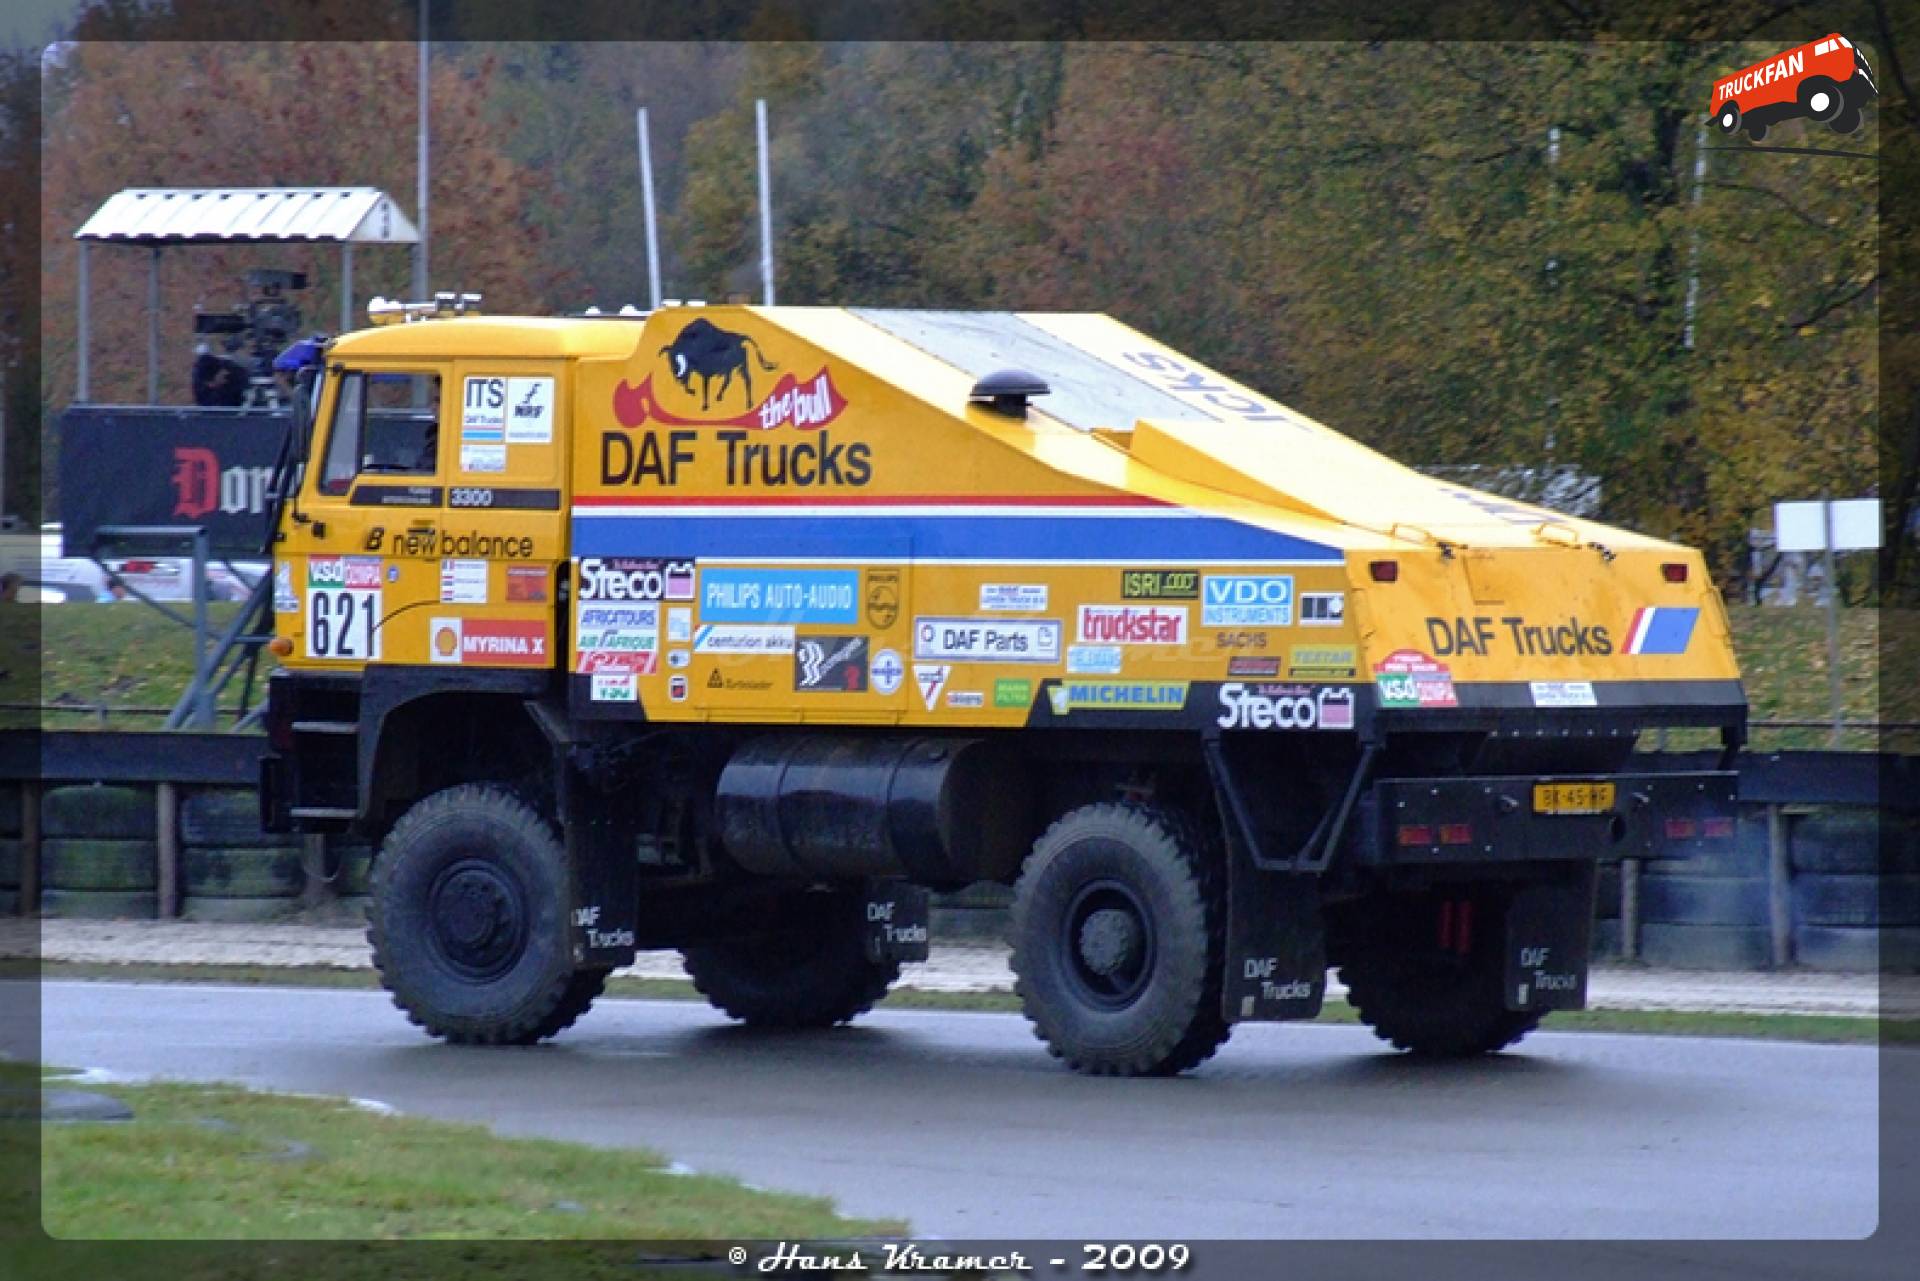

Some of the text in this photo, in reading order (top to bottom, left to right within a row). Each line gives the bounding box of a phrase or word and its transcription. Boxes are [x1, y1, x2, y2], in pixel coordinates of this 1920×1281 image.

[466, 378, 504, 408] ITS
[759, 373, 832, 429] the bull
[601, 430, 872, 486] DAF Trucks
[450, 489, 492, 506] 3300
[393, 533, 435, 556] new
[441, 530, 534, 557] balance
[579, 558, 662, 600] Steco
[1209, 580, 1287, 603] VDO
[706, 583, 761, 609] PHILIPS
[765, 583, 852, 609] AUTO-AUDIO
[312, 591, 375, 656] 621
[1083, 607, 1183, 644] truckstar
[1206, 607, 1289, 623] INSTRUMENTS
[463, 636, 545, 655] MYRINA X
[943, 629, 1030, 653] DAF Parts
[1216, 631, 1268, 649] SACHS
[1426, 617, 1613, 656] DAF Trucks
[1069, 686, 1184, 704] MICHELIN
[1217, 683, 1316, 729] Steco
